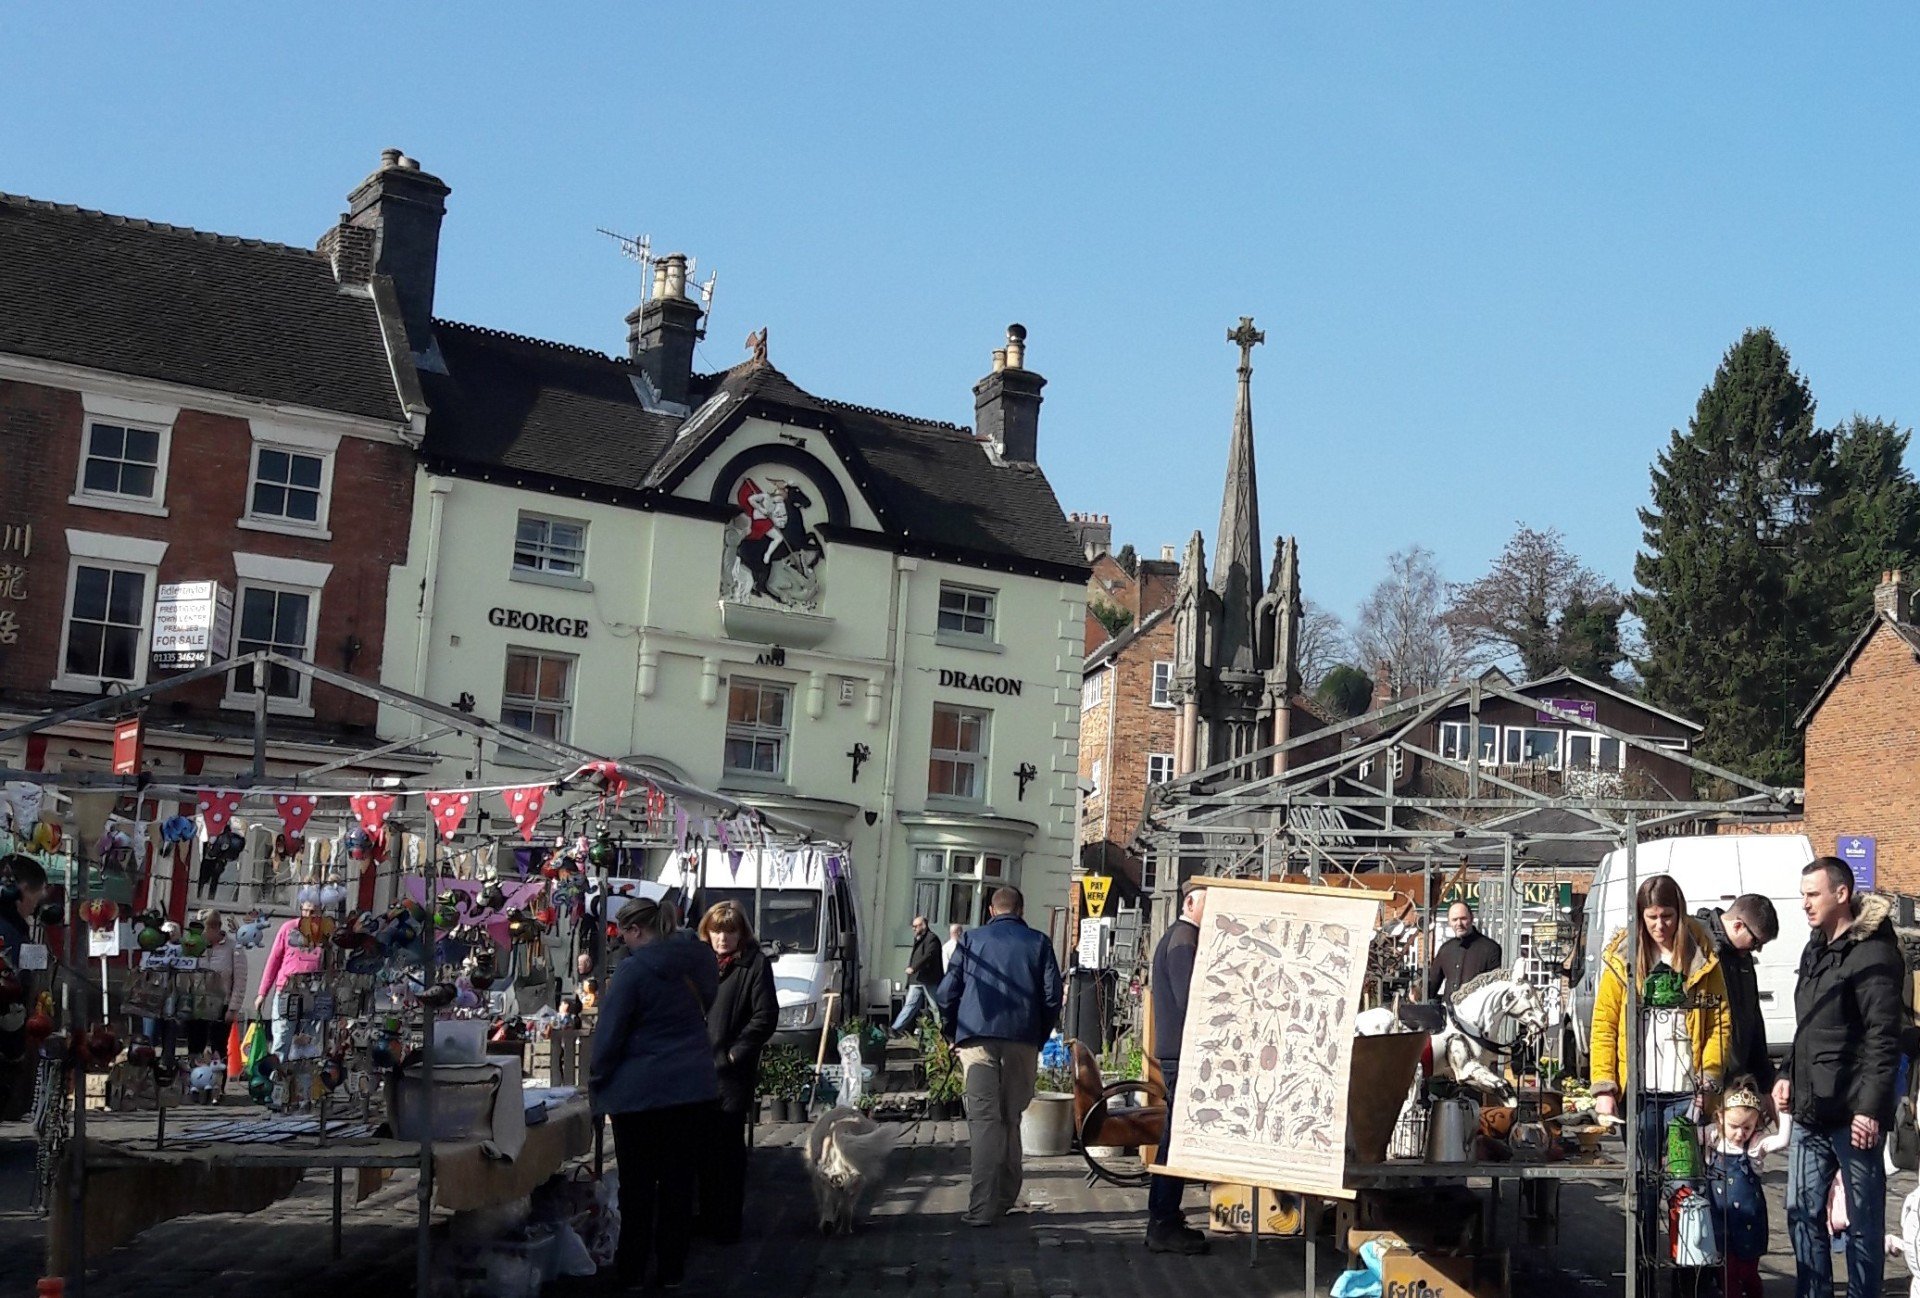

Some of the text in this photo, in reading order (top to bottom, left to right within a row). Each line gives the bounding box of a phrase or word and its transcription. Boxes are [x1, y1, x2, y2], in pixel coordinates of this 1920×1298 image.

[488, 607, 589, 639] GEORGE
[156, 635, 204, 646] FOR SALE
[755, 653, 785, 667] AND
[938, 669, 1022, 696] DRAGON
[1090, 881, 1103, 891] PAY
[1087, 891, 1105, 900] HERE
[1215, 1203, 1251, 1227] fyffe
